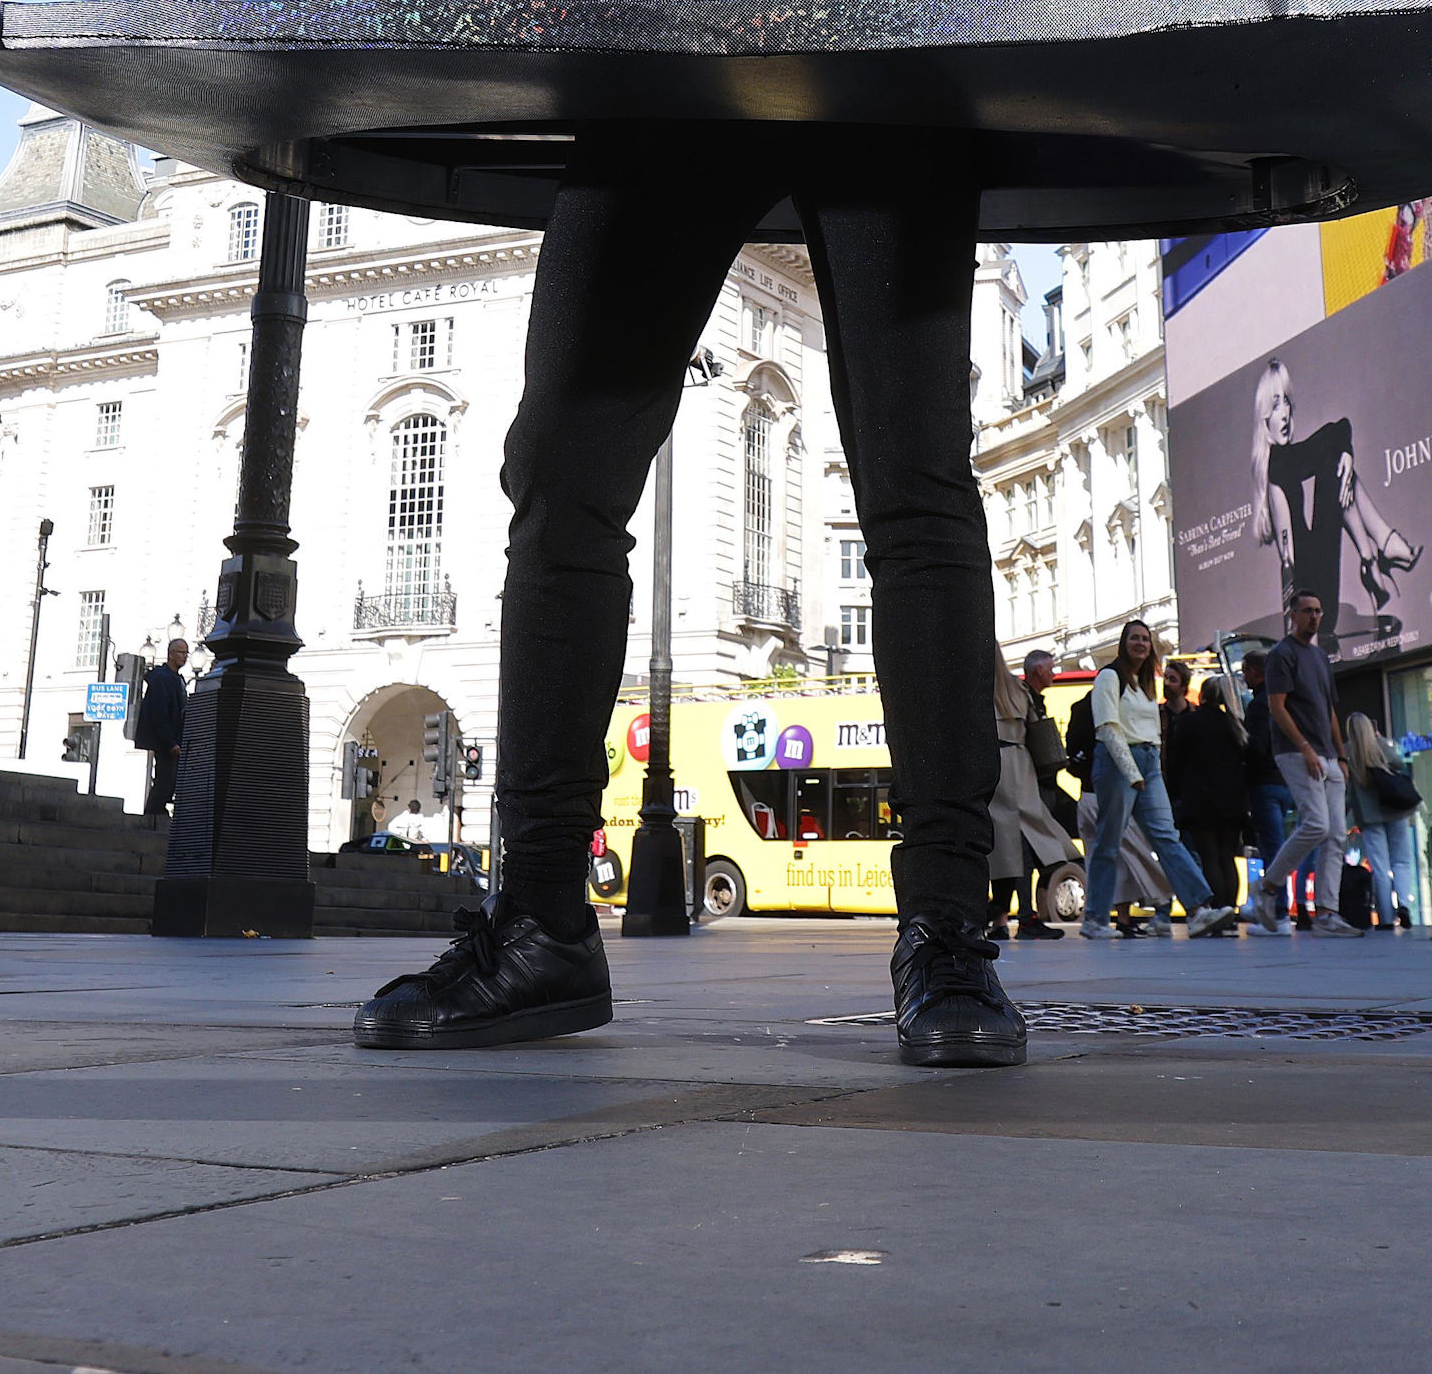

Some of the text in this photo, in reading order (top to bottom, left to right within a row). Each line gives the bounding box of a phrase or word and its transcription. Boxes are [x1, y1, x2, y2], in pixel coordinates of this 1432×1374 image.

[346, 292, 395, 312] HOTEL
[449, 280, 499, 299] ROYAL
[759, 272, 774, 291] LIFE
[777, 282, 799, 304] OFFICE
[1209, 503, 1253, 531] CARPENTER
[837, 723, 889, 746] m&m
[786, 862, 893, 888] find us in Leice
